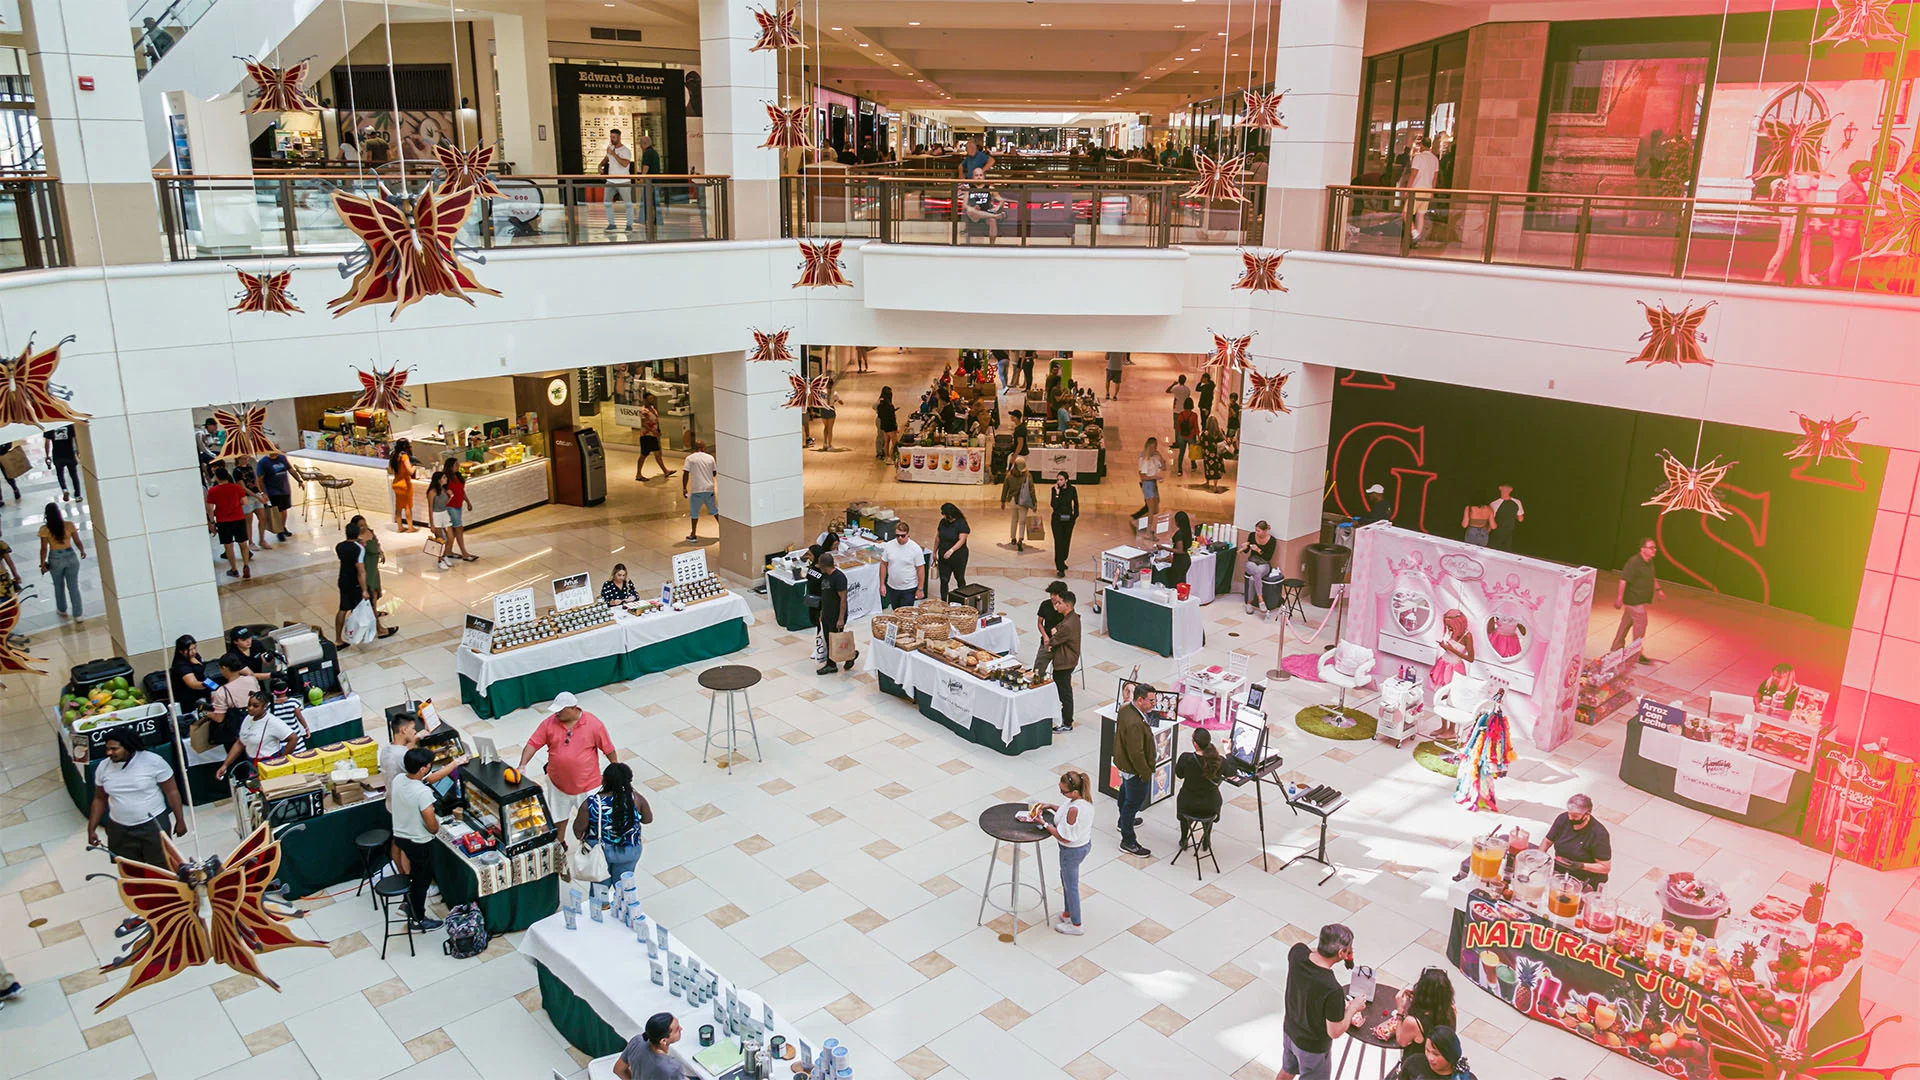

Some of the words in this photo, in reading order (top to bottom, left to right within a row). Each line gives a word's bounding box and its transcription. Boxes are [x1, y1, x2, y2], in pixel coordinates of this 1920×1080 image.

[578, 71, 623, 83] Edward
[626, 73, 665, 84] Beiner
[620, 407, 641, 416] VERSAC
[1642, 702, 1668, 716] Arroz
[1645, 711, 1663, 721] con
[1639, 715, 1667, 729] Leche
[91, 720, 155, 743] COTS
[1682, 775, 1709, 786] CHICHA
[1710, 783, 1742, 796] CRIOLLA
[1466, 920, 1626, 978] NATURAL
[1635, 969, 1746, 1037] JUI
